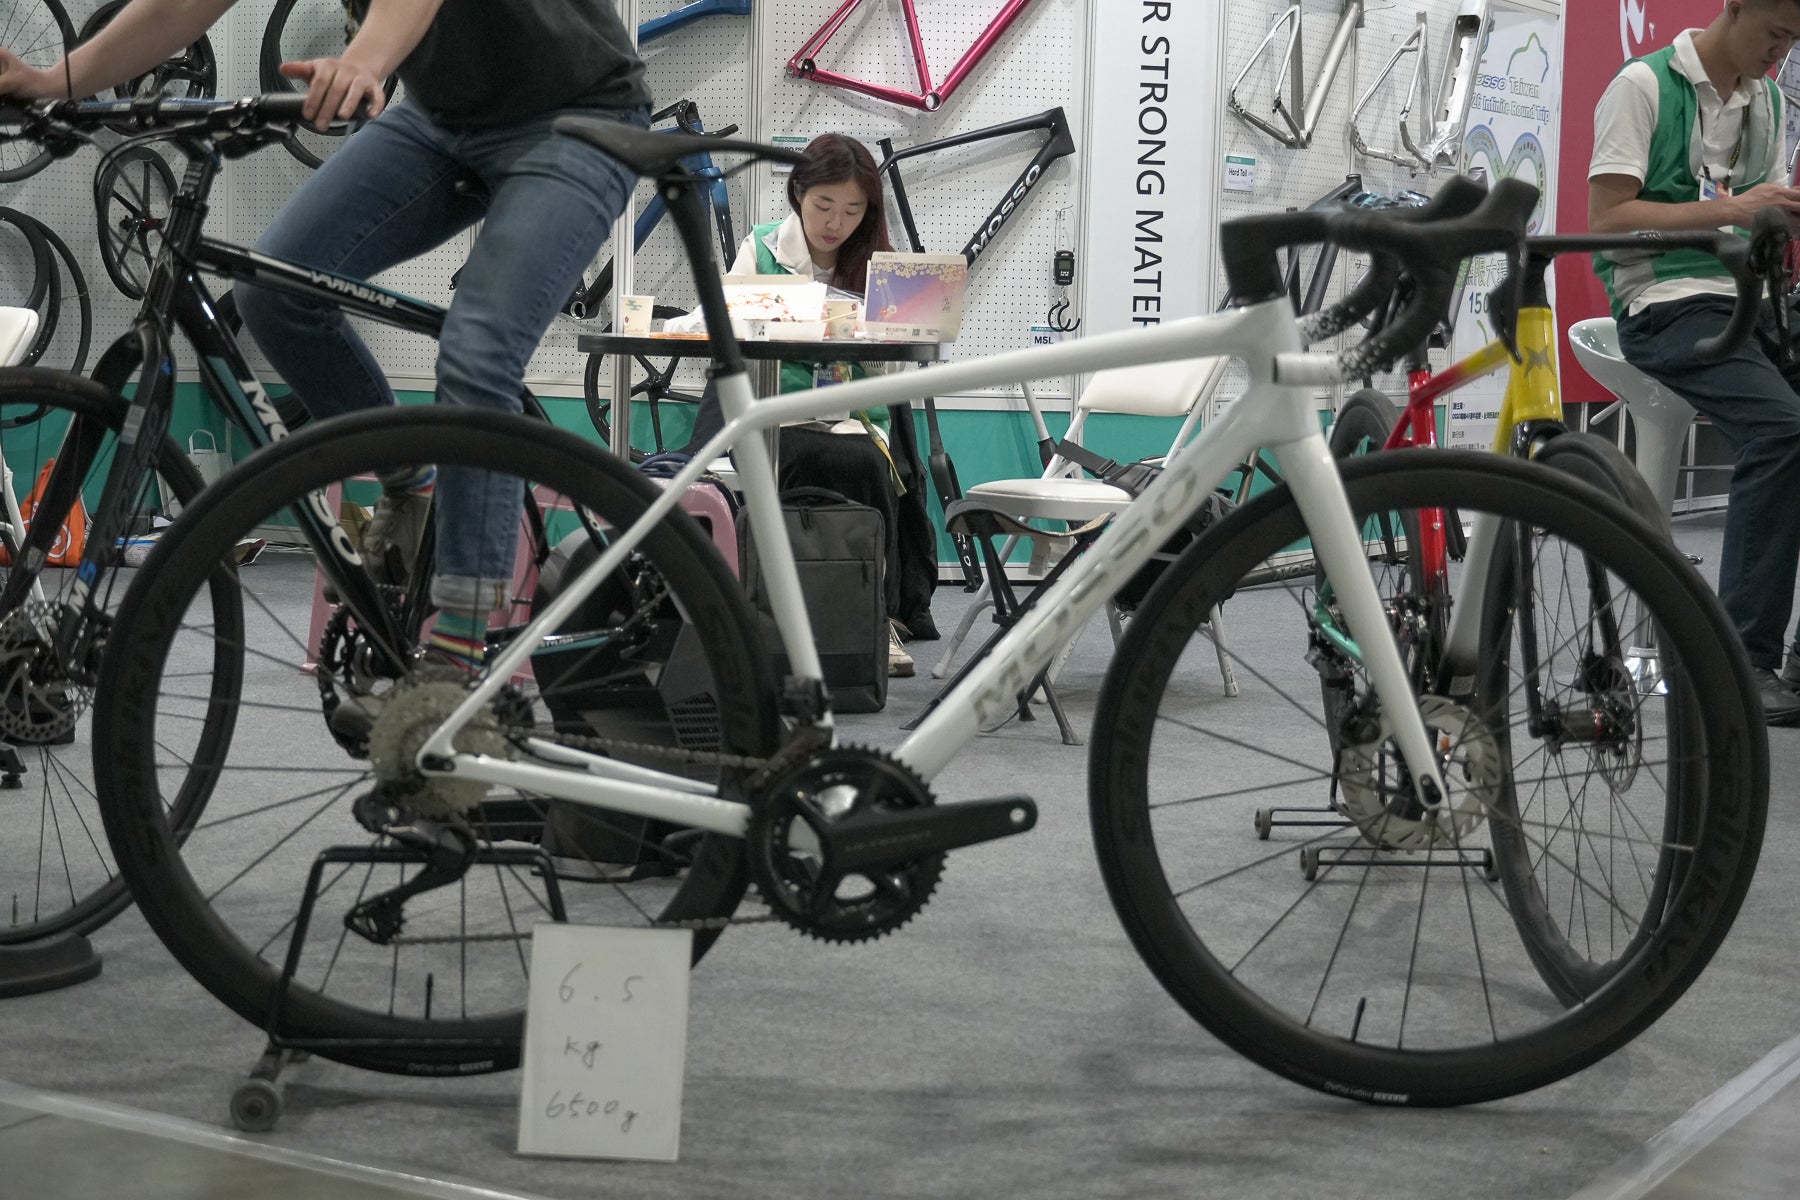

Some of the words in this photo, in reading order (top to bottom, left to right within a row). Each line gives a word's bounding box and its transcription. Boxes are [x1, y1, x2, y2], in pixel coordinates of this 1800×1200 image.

[1508, 76, 1540, 99] Taiwan
[1135, 35, 1171, 196] STRONG
[1482, 95, 1510, 116] Infinite
[1510, 101, 1535, 120] Round
[1535, 105, 1550, 126] Trip
[970, 164, 1040, 260] MOSSO
[1034, 335, 1055, 345] M5L
[970, 463, 1199, 725] MOSSO
[545, 1089, 639, 1133] 6500g
